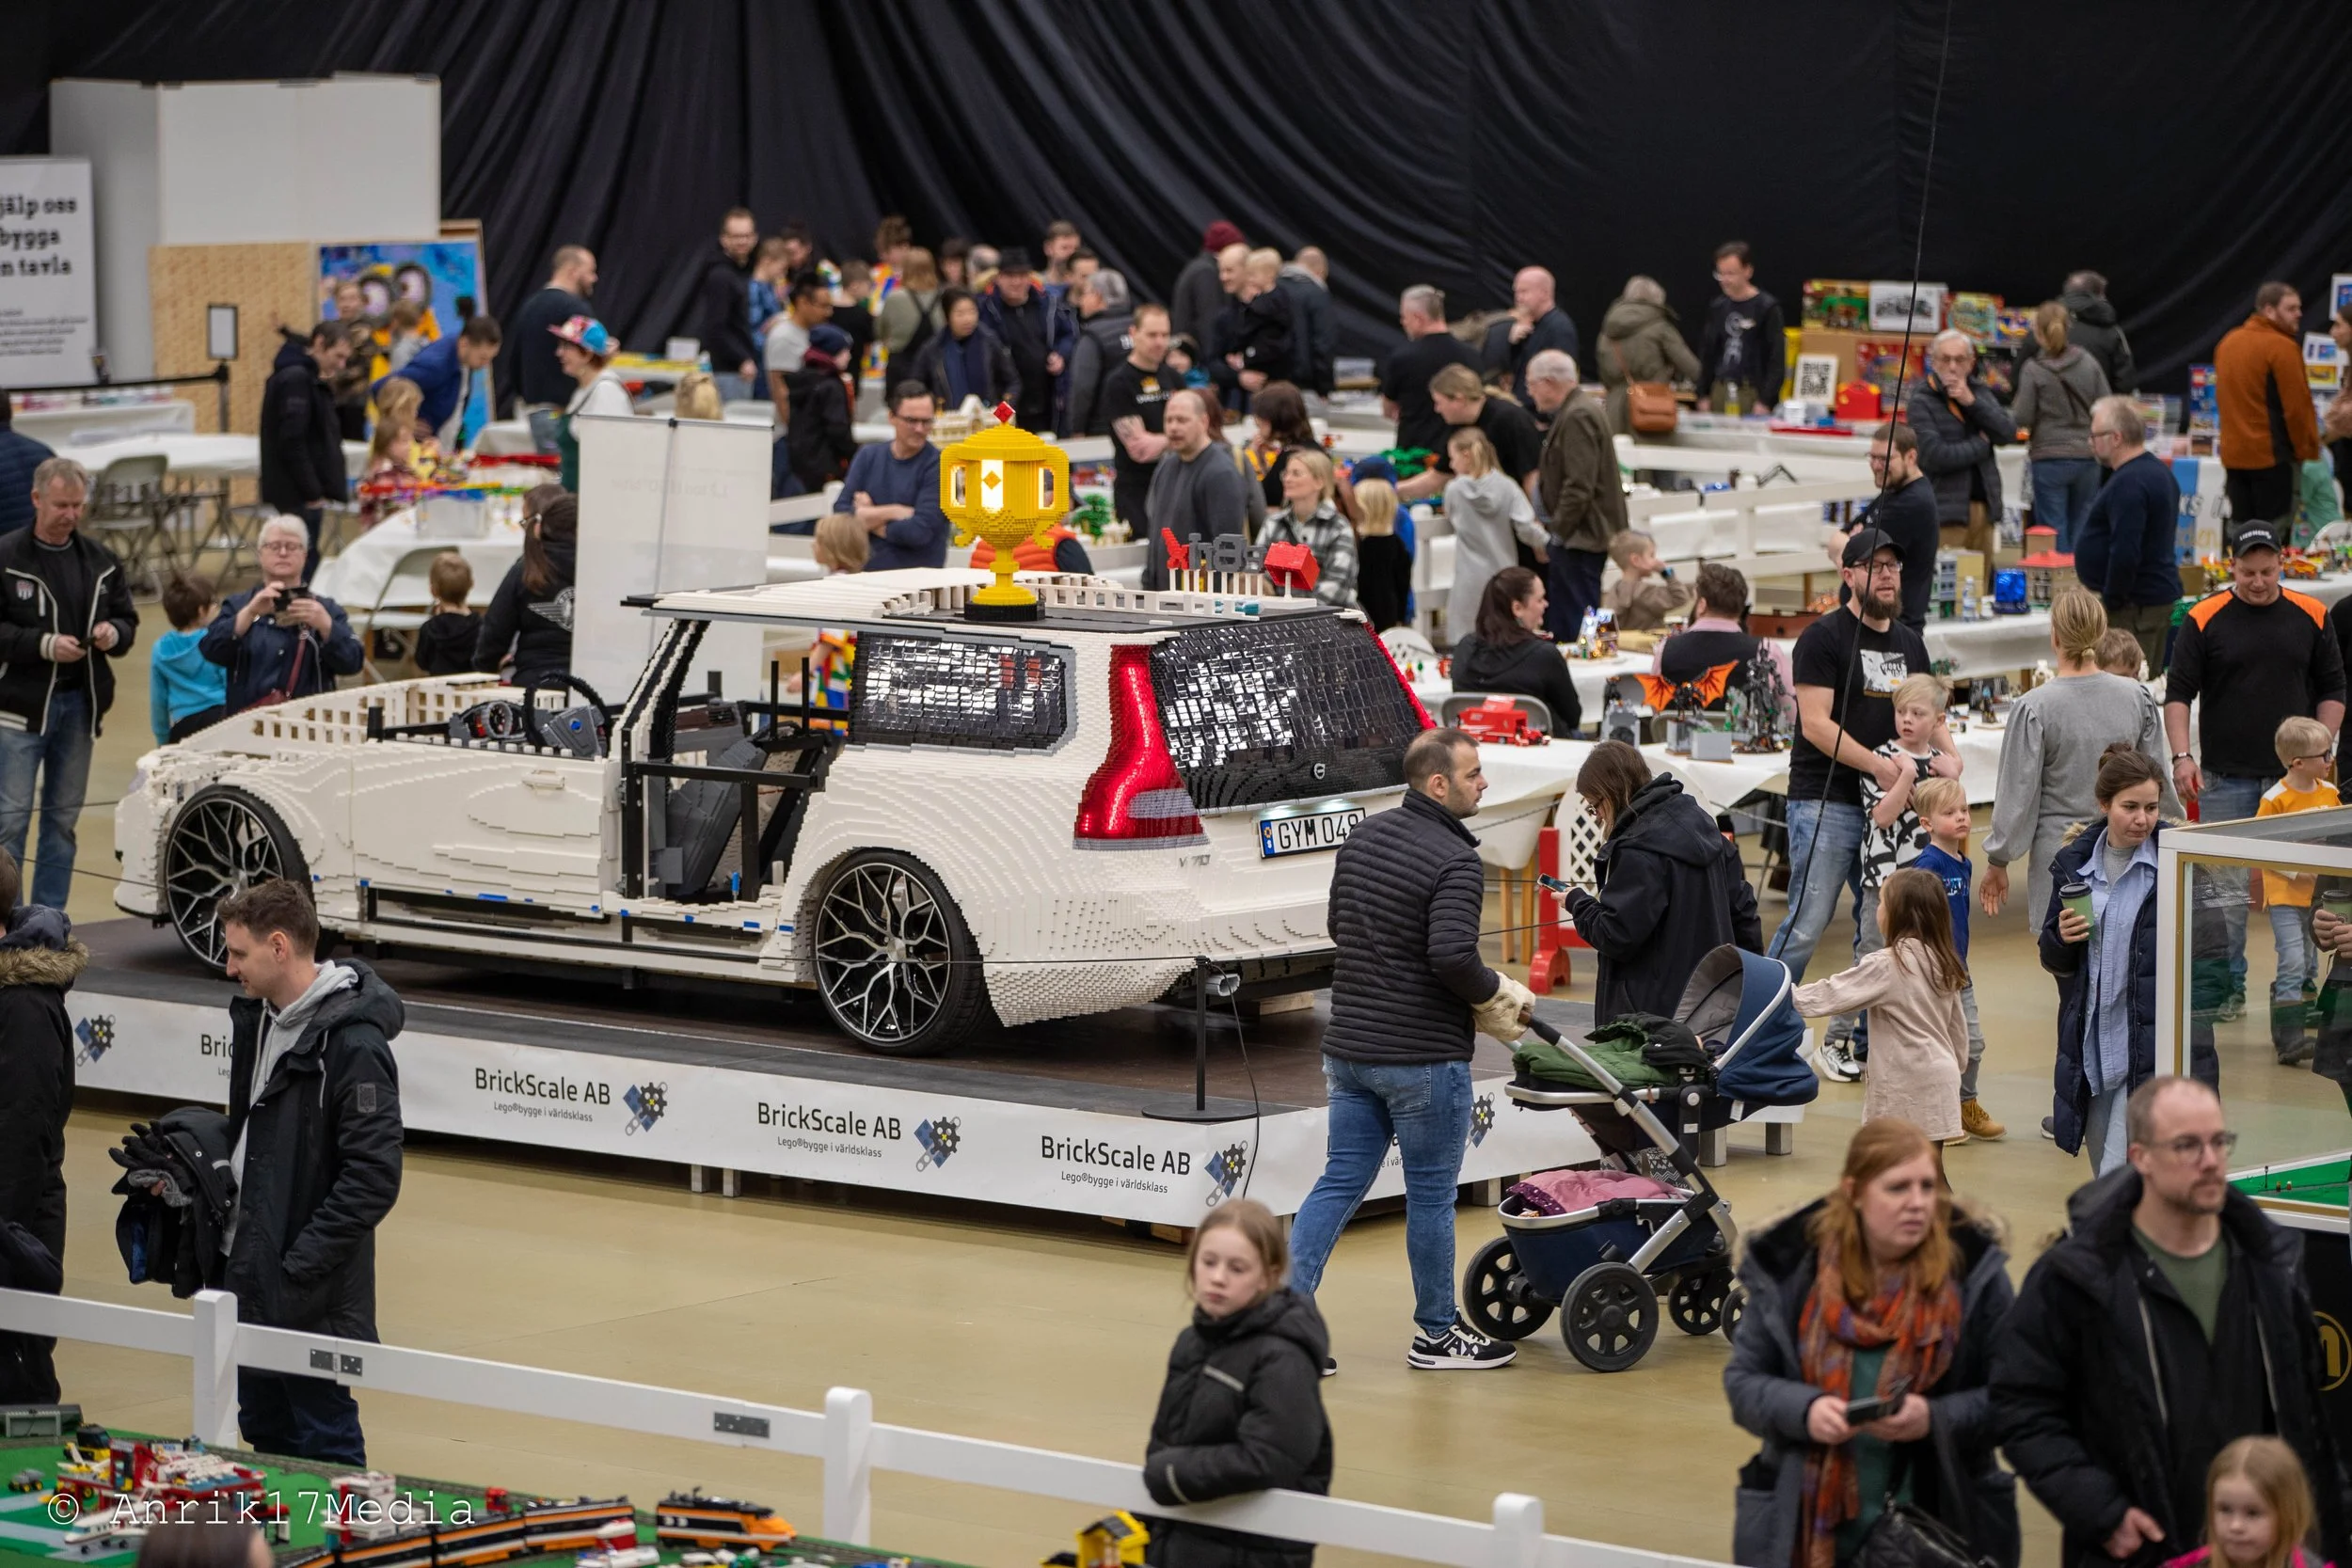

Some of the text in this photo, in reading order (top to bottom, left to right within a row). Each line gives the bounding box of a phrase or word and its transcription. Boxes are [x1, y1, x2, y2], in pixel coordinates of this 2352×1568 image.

[43, 198, 77, 215] oss
[19, 254, 72, 277] tavla
[1279, 818, 1317, 849] GYM
[475, 1068, 611, 1105] BrickScale AB
[494, 1101, 542, 1118] Lego®bygge
[548, 1108, 593, 1122] världsklass
[757, 1101, 901, 1140] BrickScale AB
[777, 1136, 828, 1153] Lego®bygge
[834, 1143, 882, 1158] världsklass
[1041, 1135, 1191, 1176] BrickScale AB
[1061, 1171, 1114, 1187] Lego®bygge
[1120, 1179, 1168, 1194] världsklass
